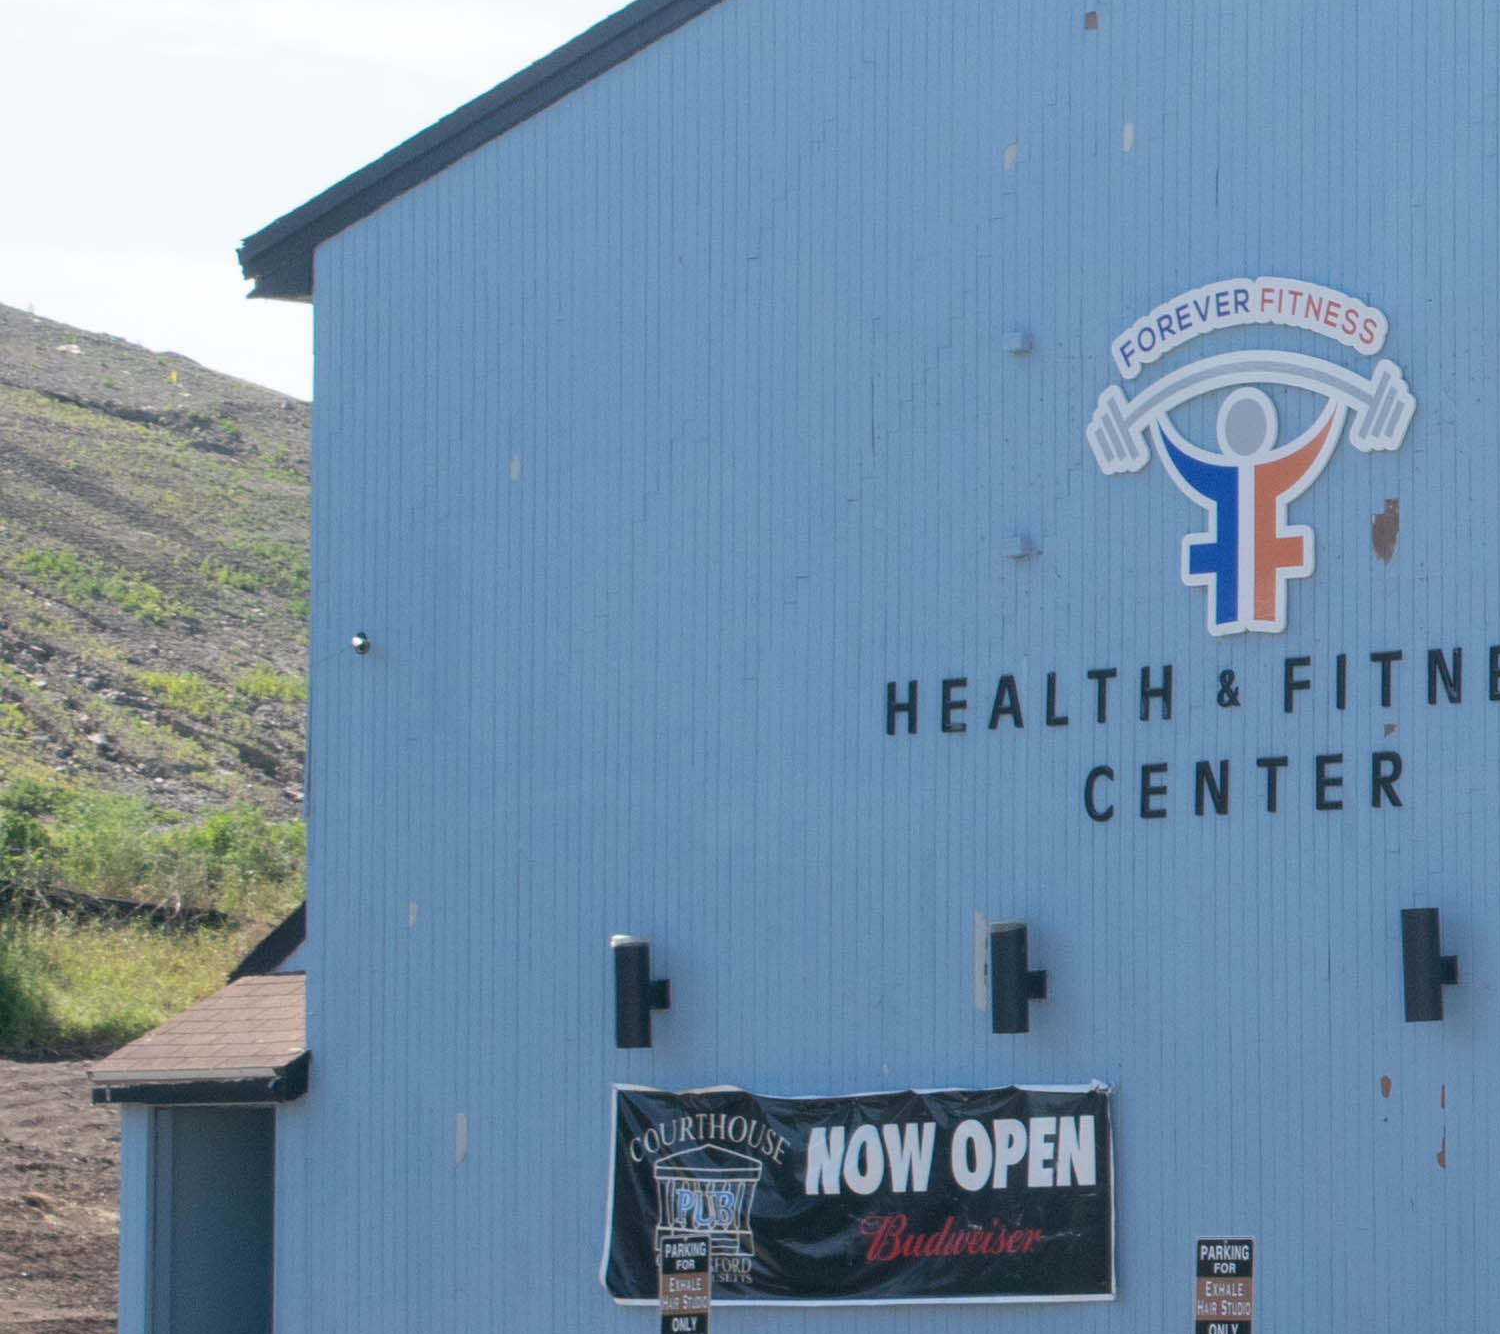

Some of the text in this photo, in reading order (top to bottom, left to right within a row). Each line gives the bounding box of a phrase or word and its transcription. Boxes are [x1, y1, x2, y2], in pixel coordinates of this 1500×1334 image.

[1120, 287, 1378, 367] FOREVER FITNESS
[886, 664, 1172, 735] HEALTH
[1217, 668, 1241, 708] &
[1084, 751, 1403, 821] CENTER
[630, 1113, 791, 1165] COURTHOUSE
[805, 1115, 1096, 1195] NOW OPEN
[676, 1188, 735, 1229] PUB
[665, 1241, 707, 1258] PARKING
[860, 1214, 1042, 1262] Budweiser
[676, 1259, 695, 1270] FOR
[1200, 1245, 1250, 1261] PARKING
[1213, 1263, 1236, 1274] FOR
[1205, 1281, 1244, 1297] EXHALE
[1221, 1300, 1251, 1316] STUDIO
[671, 1317, 698, 1332] ONLY
